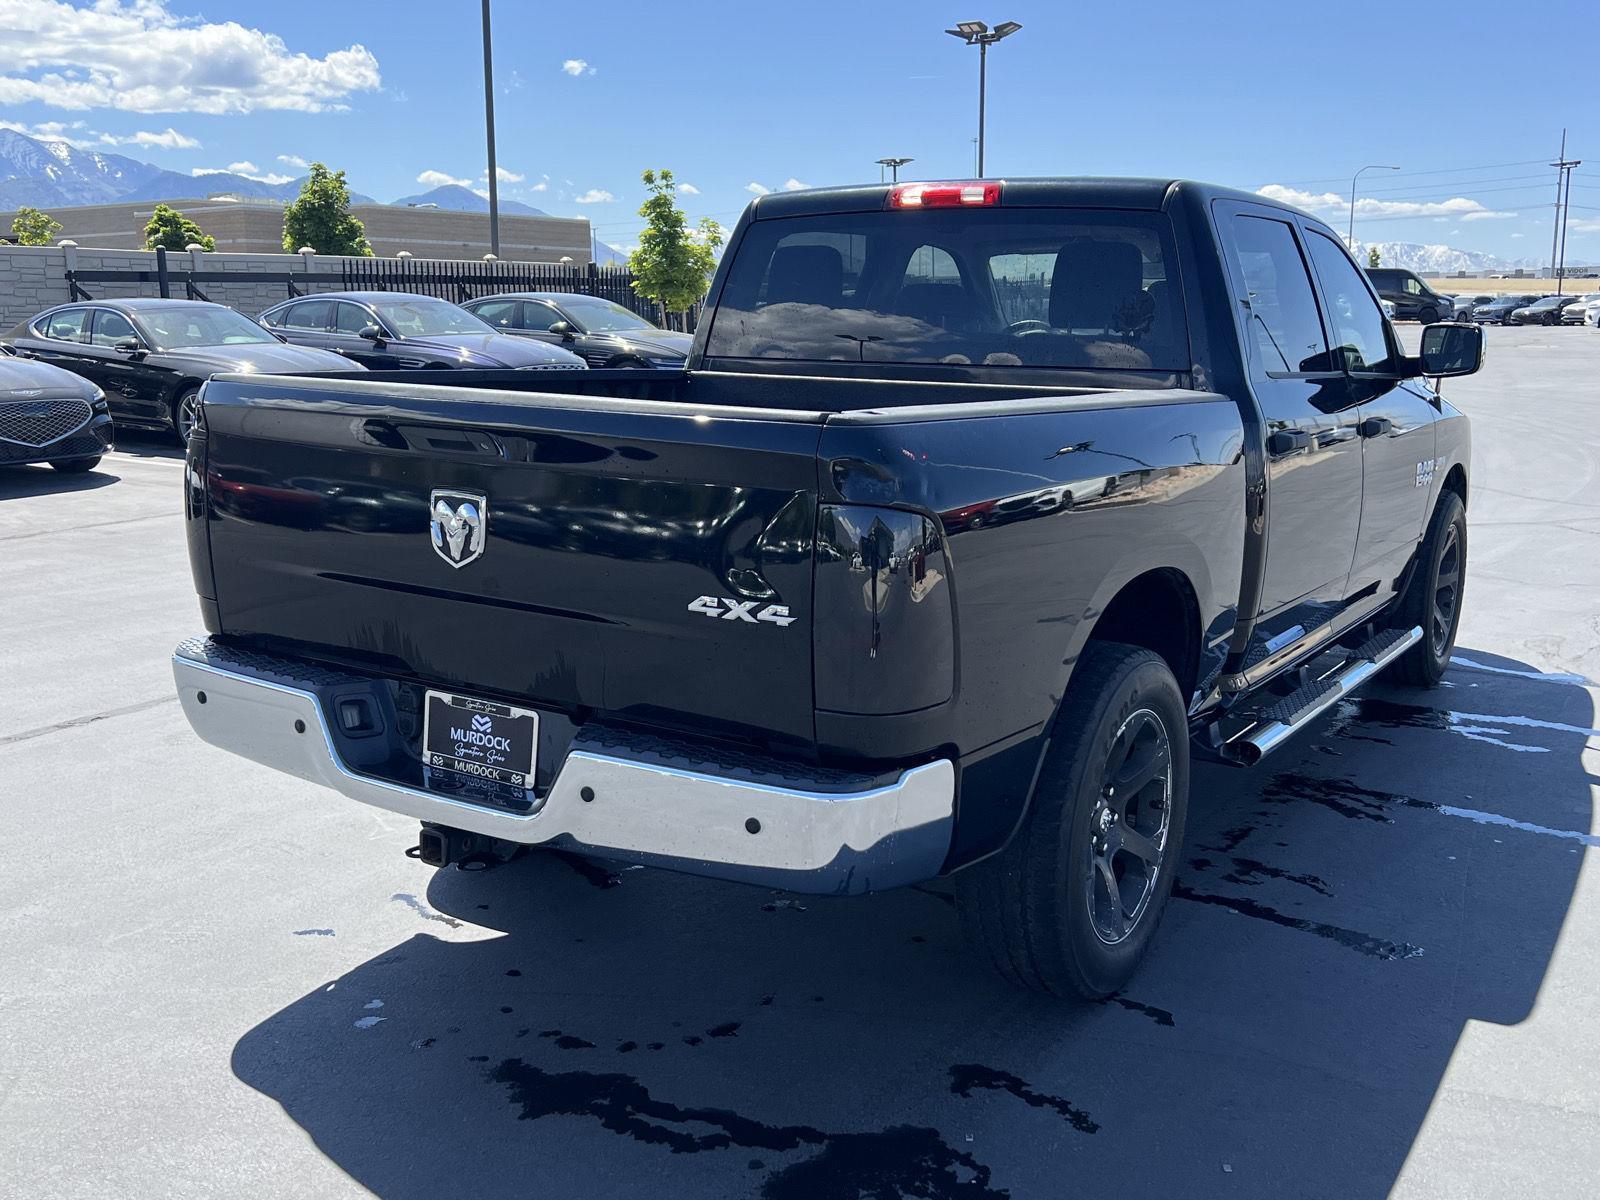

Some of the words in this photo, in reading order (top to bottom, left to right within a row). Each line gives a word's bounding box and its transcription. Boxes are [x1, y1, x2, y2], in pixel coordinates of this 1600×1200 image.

[450, 727, 511, 752] MURDOCK
[454, 742, 485, 758] Signature
[486, 749, 506, 764] Series
[454, 760, 501, 780] MURDOCK
